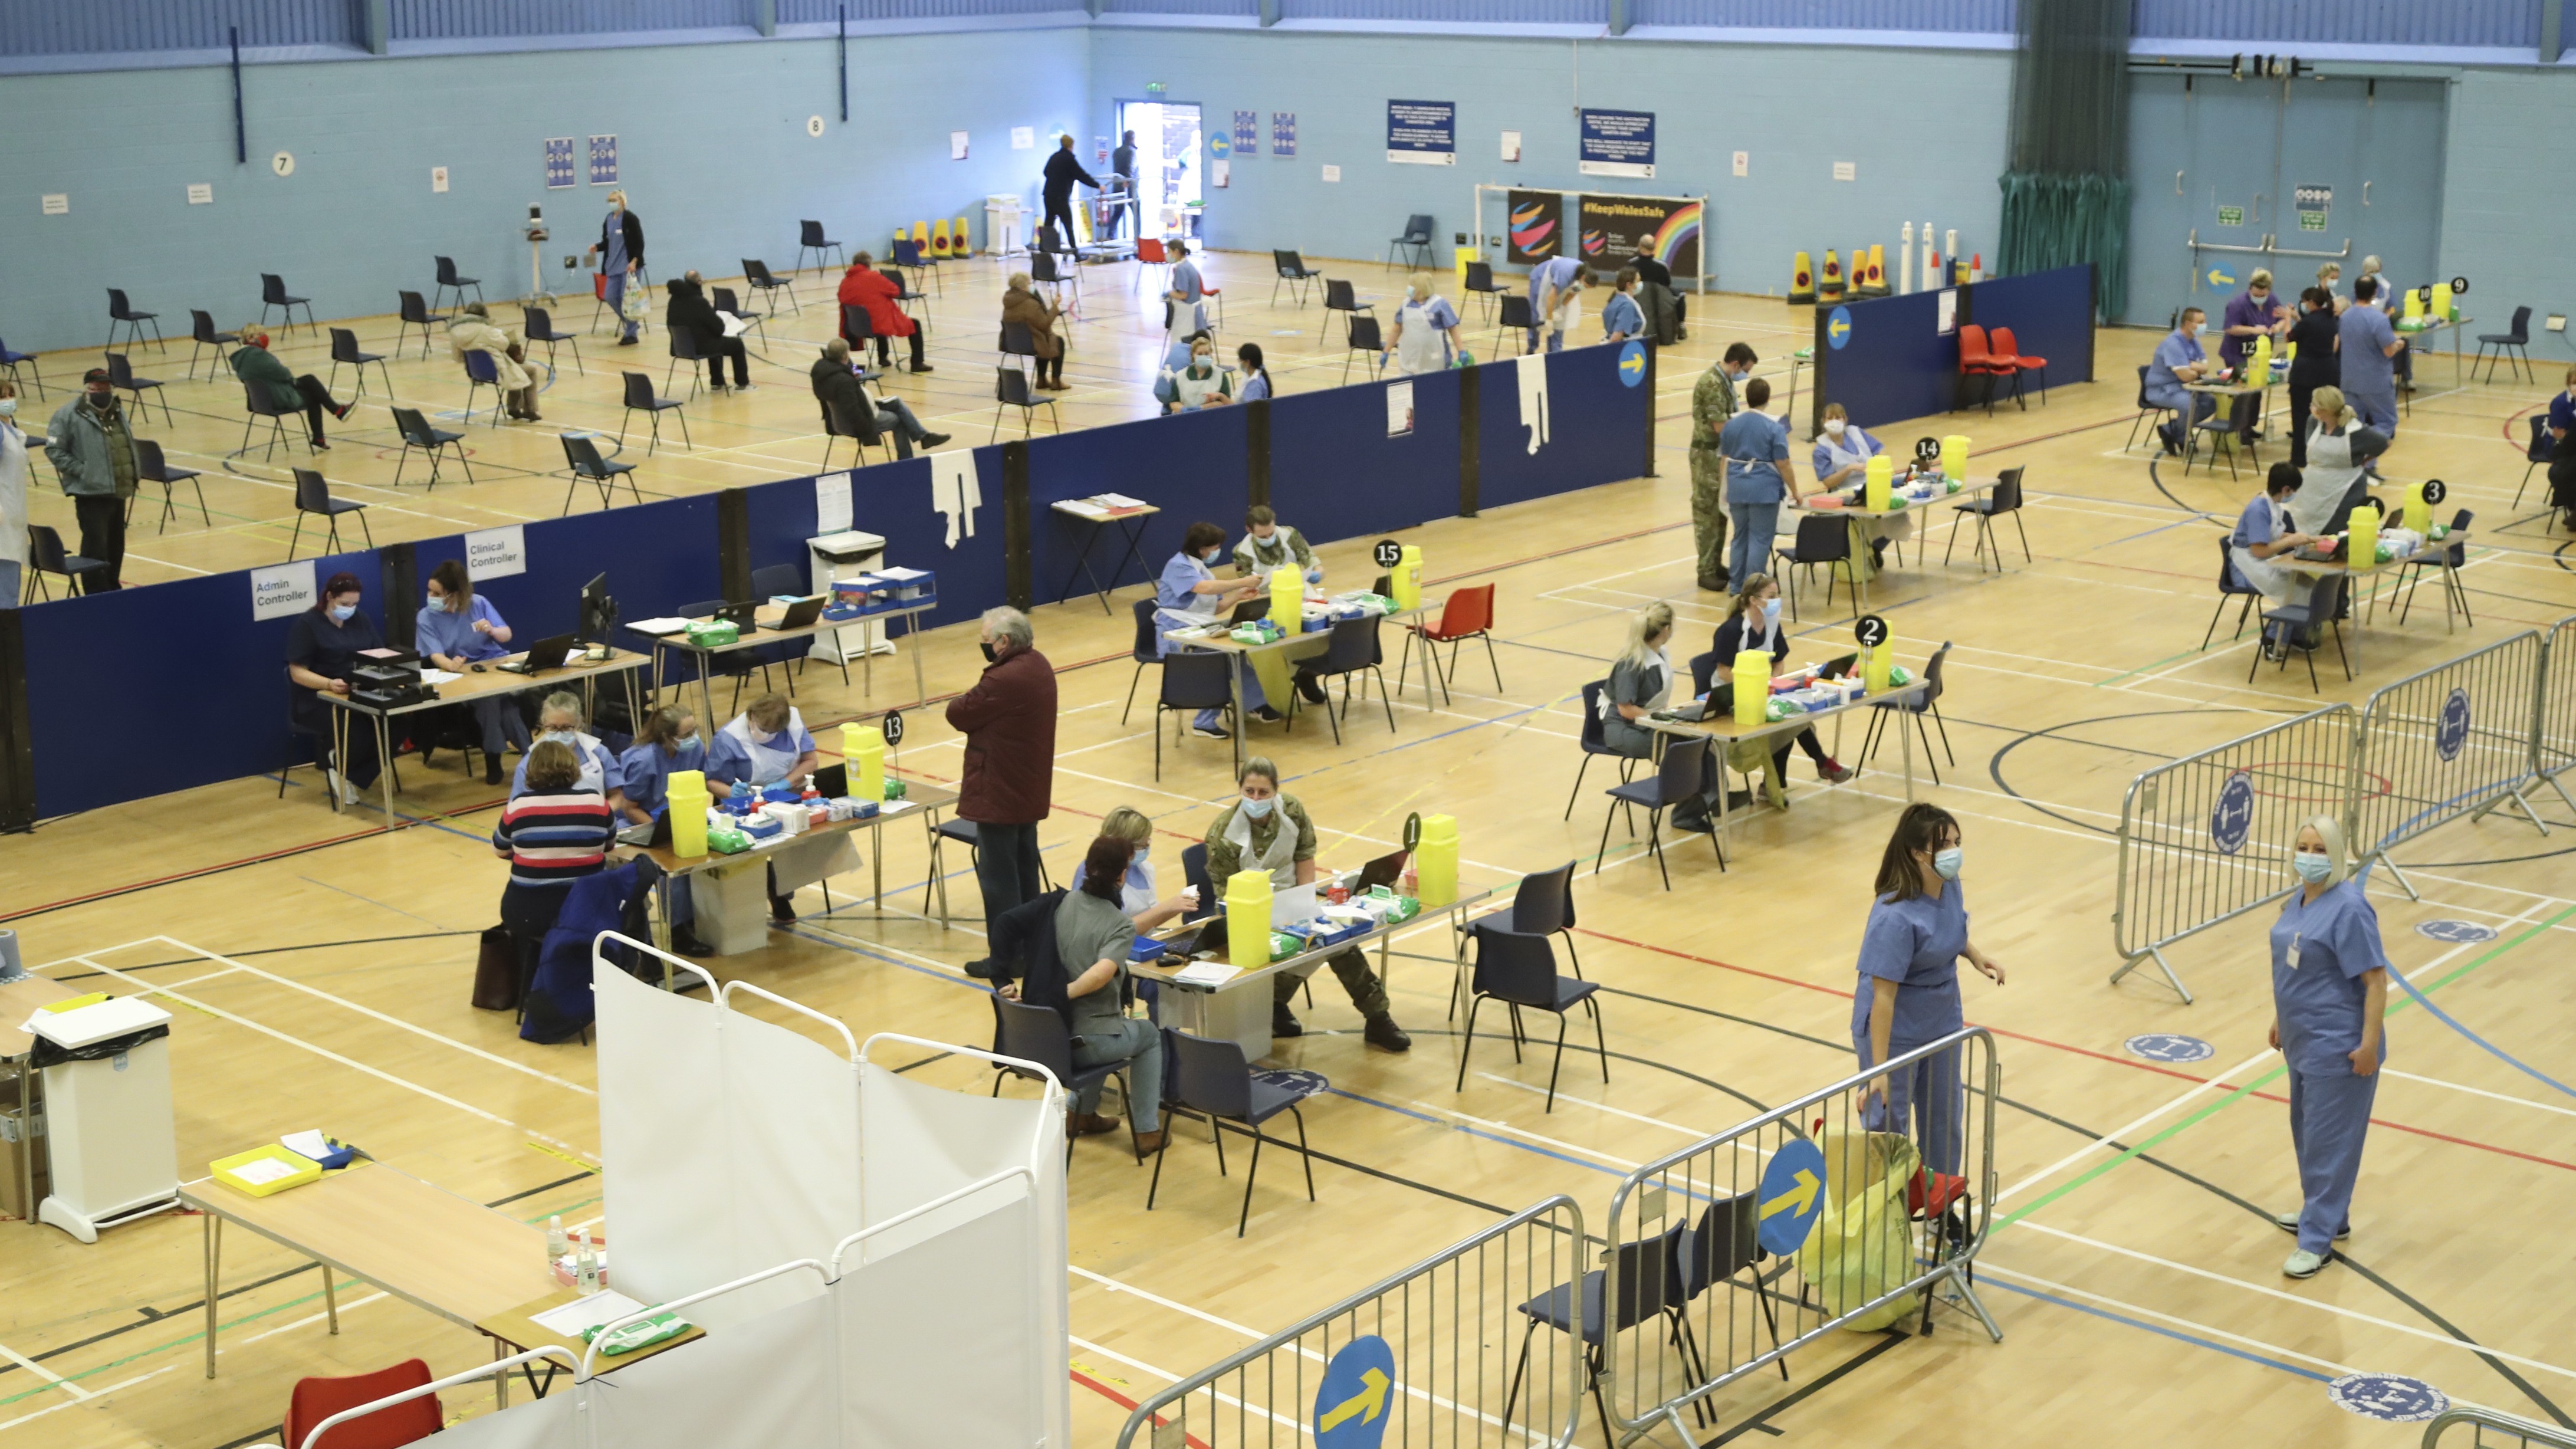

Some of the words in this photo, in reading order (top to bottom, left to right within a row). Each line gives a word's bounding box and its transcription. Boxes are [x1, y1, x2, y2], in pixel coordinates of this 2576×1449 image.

[813, 120, 819, 132] 8
[279, 157, 287, 171] 7
[1583, 202, 1665, 218] #KeepWalesSafe
[2455, 278, 2465, 293] 9
[2420, 288, 2430, 300] 10
[2242, 341, 2255, 354] 12
[1919, 441, 1938, 456] 14
[2427, 482, 2440, 501] 3
[470, 541, 504, 554] Clinical
[1378, 545, 1398, 561] 15
[471, 553, 517, 567] Controller
[257, 580, 289, 593] Admin
[257, 591, 308, 606] Controller
[1863, 619, 1880, 641] 2
[886, 717, 902, 738] 13
[1409, 818, 1416, 843] 1
